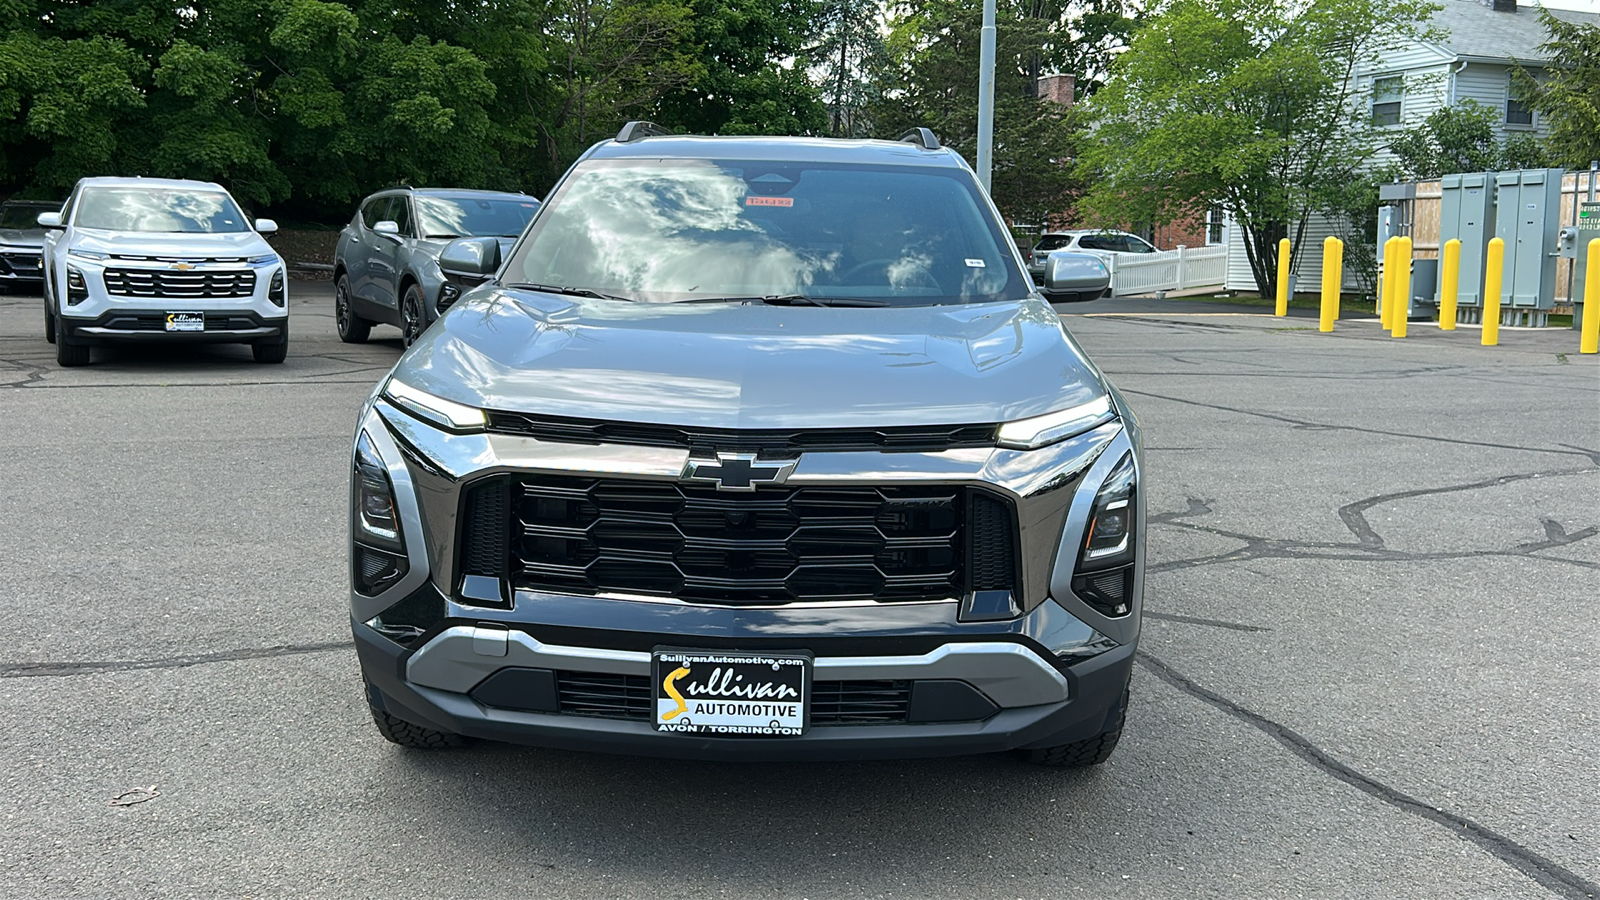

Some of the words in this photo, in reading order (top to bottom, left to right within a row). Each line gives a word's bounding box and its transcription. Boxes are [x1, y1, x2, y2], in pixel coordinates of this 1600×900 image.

[660, 654, 803, 665] SullivanAutomotive.com
[663, 666, 798, 720] Sullivan
[695, 703, 797, 717] AUTOMOTIVE
[658, 724, 697, 732] AVON
[709, 725, 801, 735] TORRINGTON
